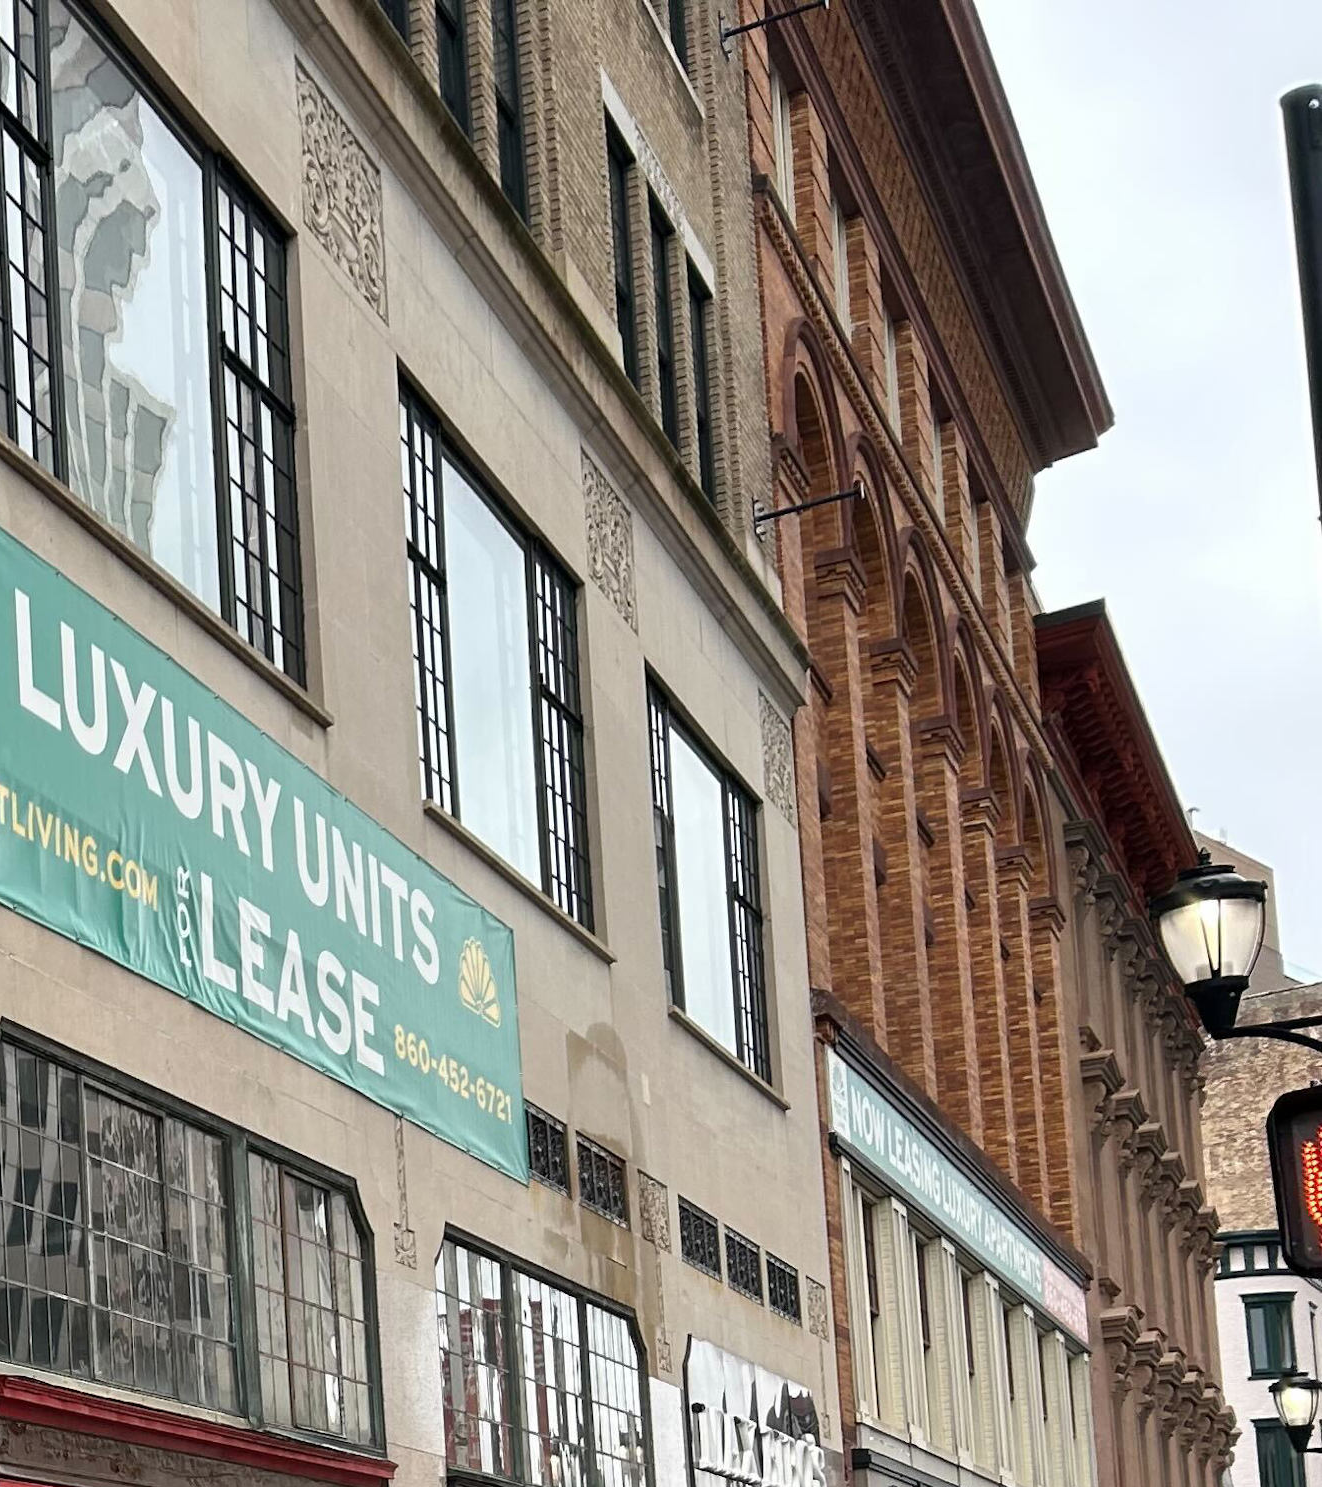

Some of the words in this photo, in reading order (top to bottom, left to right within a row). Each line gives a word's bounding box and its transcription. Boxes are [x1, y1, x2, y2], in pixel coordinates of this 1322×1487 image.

[13, 587, 281, 872] LUXURY
[293, 795, 441, 986] UNITS
[175, 866, 192, 967] FOR
[198, 871, 385, 1077] LEASE
[394, 1023, 513, 1125] 860-452-6721
[851, 1087, 885, 1154] NOW
[887, 1120, 941, 1206] LEASING
[941, 1174, 983, 1239] LUXURY
[984, 1210, 1042, 1291] APARTMENTS
